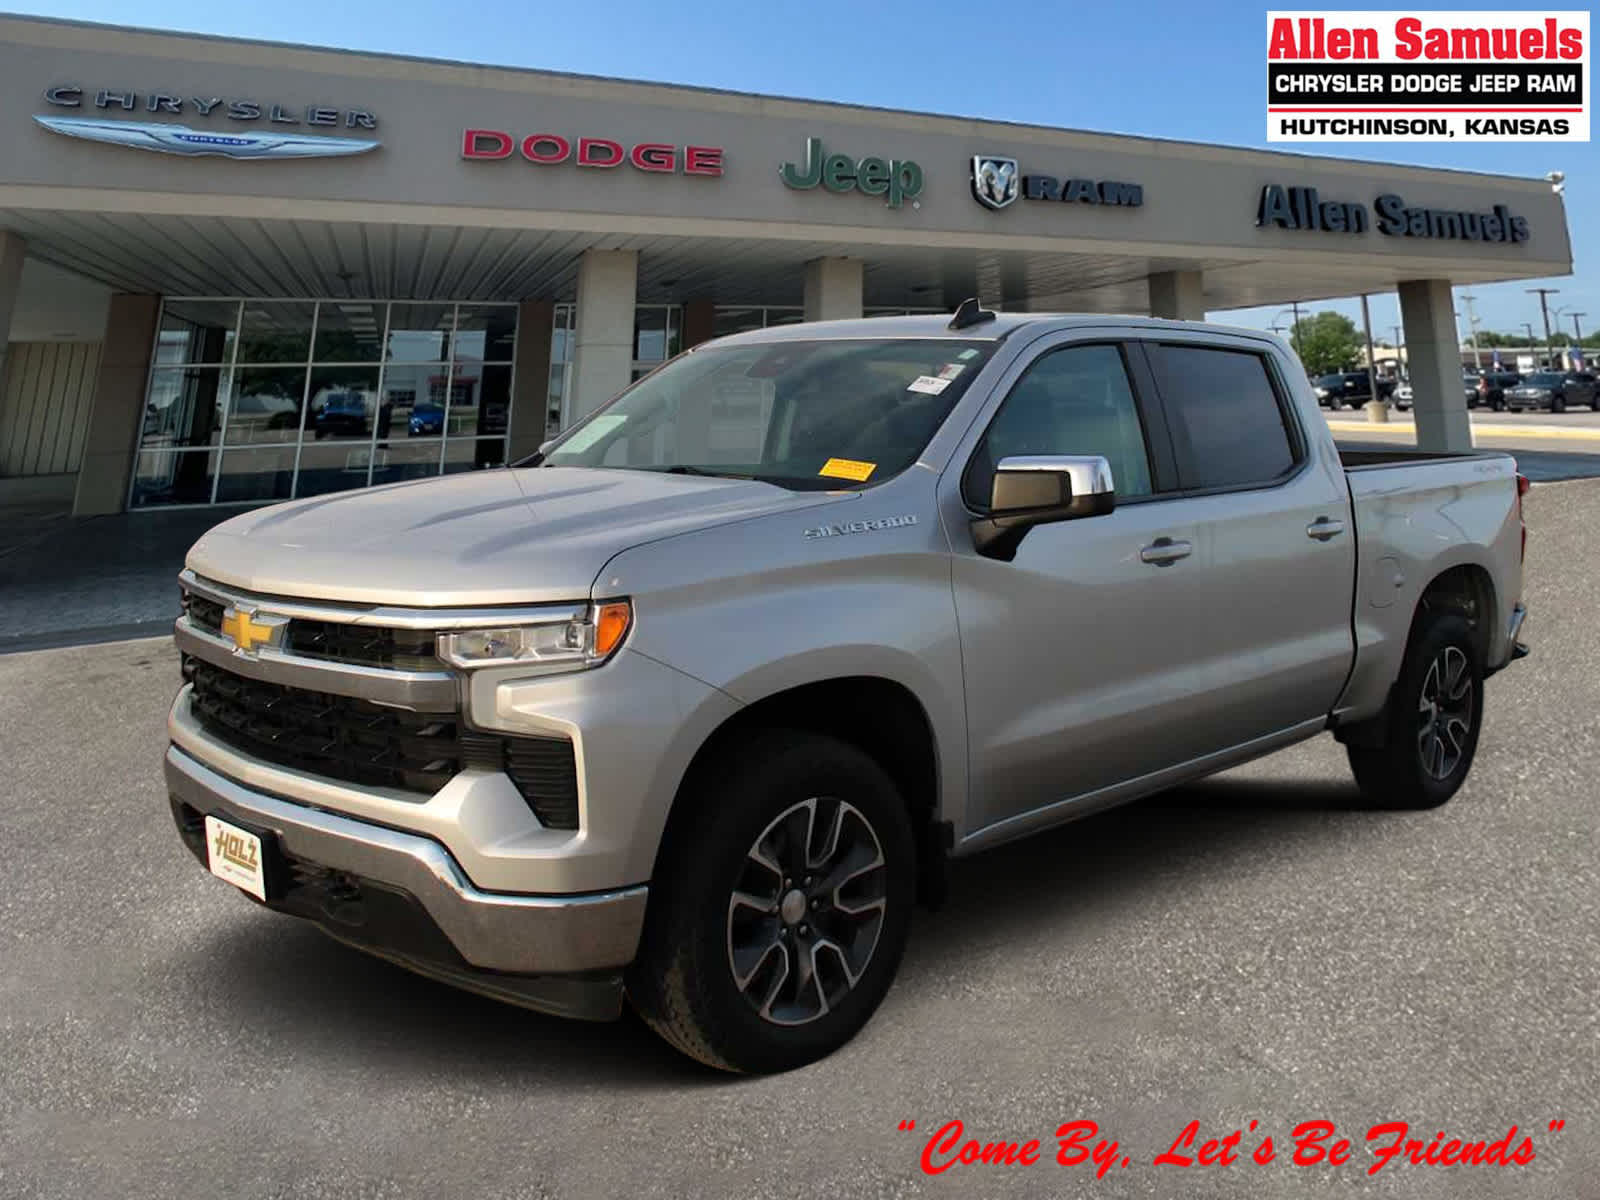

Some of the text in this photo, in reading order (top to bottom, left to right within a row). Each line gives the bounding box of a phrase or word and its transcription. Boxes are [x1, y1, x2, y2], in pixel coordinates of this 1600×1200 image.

[45, 86, 377, 129] CHRYSLER
[461, 128, 724, 176] DODGE
[779, 136, 923, 210] Jeep
[1023, 174, 1144, 208] RAM
[1256, 184, 1530, 243] Allen Samuels
[803, 514, 918, 539] SILVERADO
